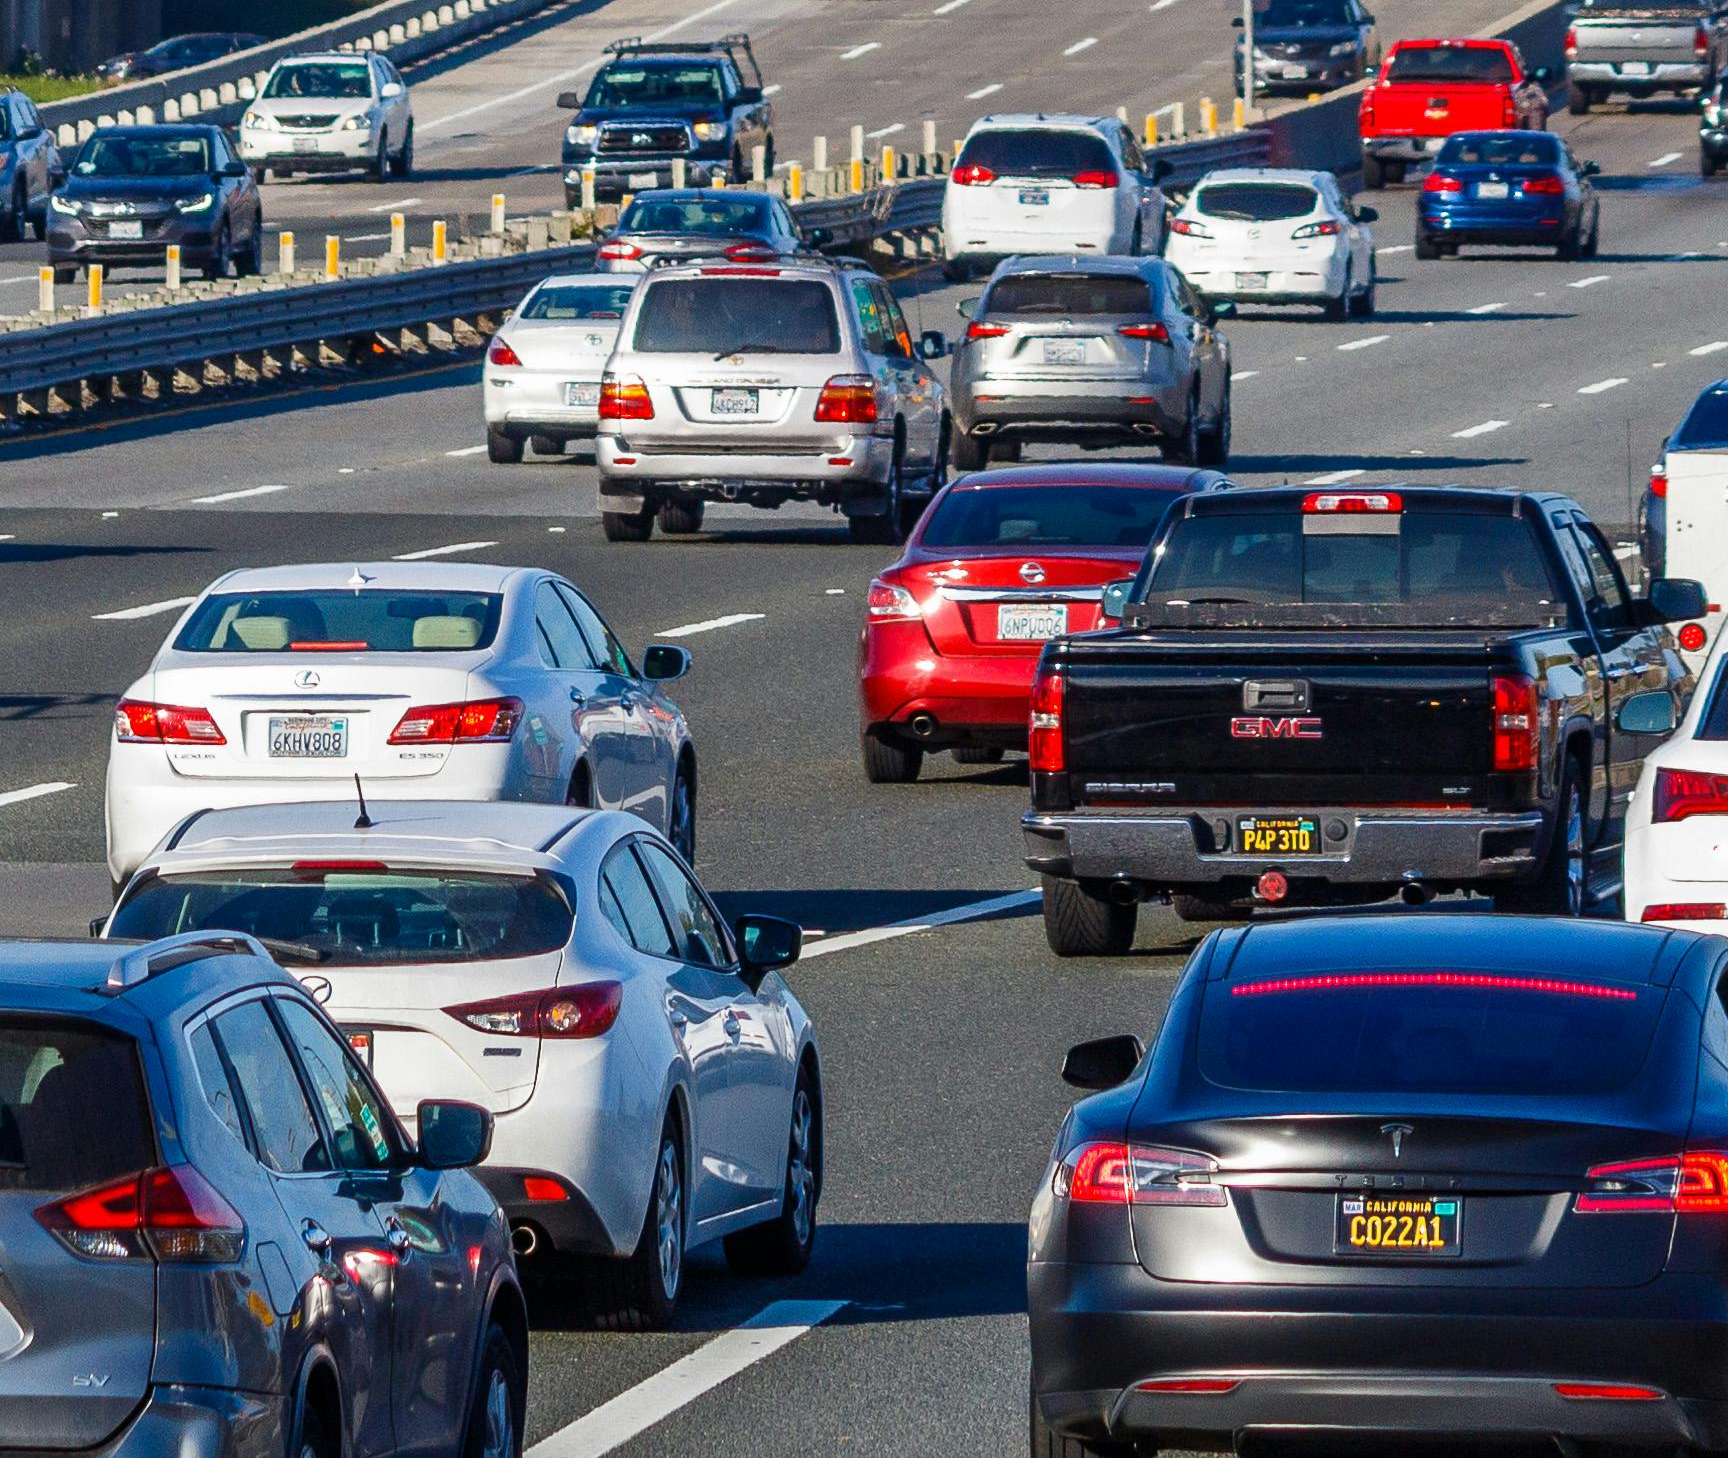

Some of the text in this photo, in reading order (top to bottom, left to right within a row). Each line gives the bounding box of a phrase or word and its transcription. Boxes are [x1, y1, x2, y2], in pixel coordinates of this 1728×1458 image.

[1230, 717, 1322, 738] GMC
[273, 732, 341, 751] 6KHV808
[1244, 829, 1276, 851] P4P
[1366, 1201, 1432, 1213] CALIFORNIA
[72, 1373, 113, 1387] SV
